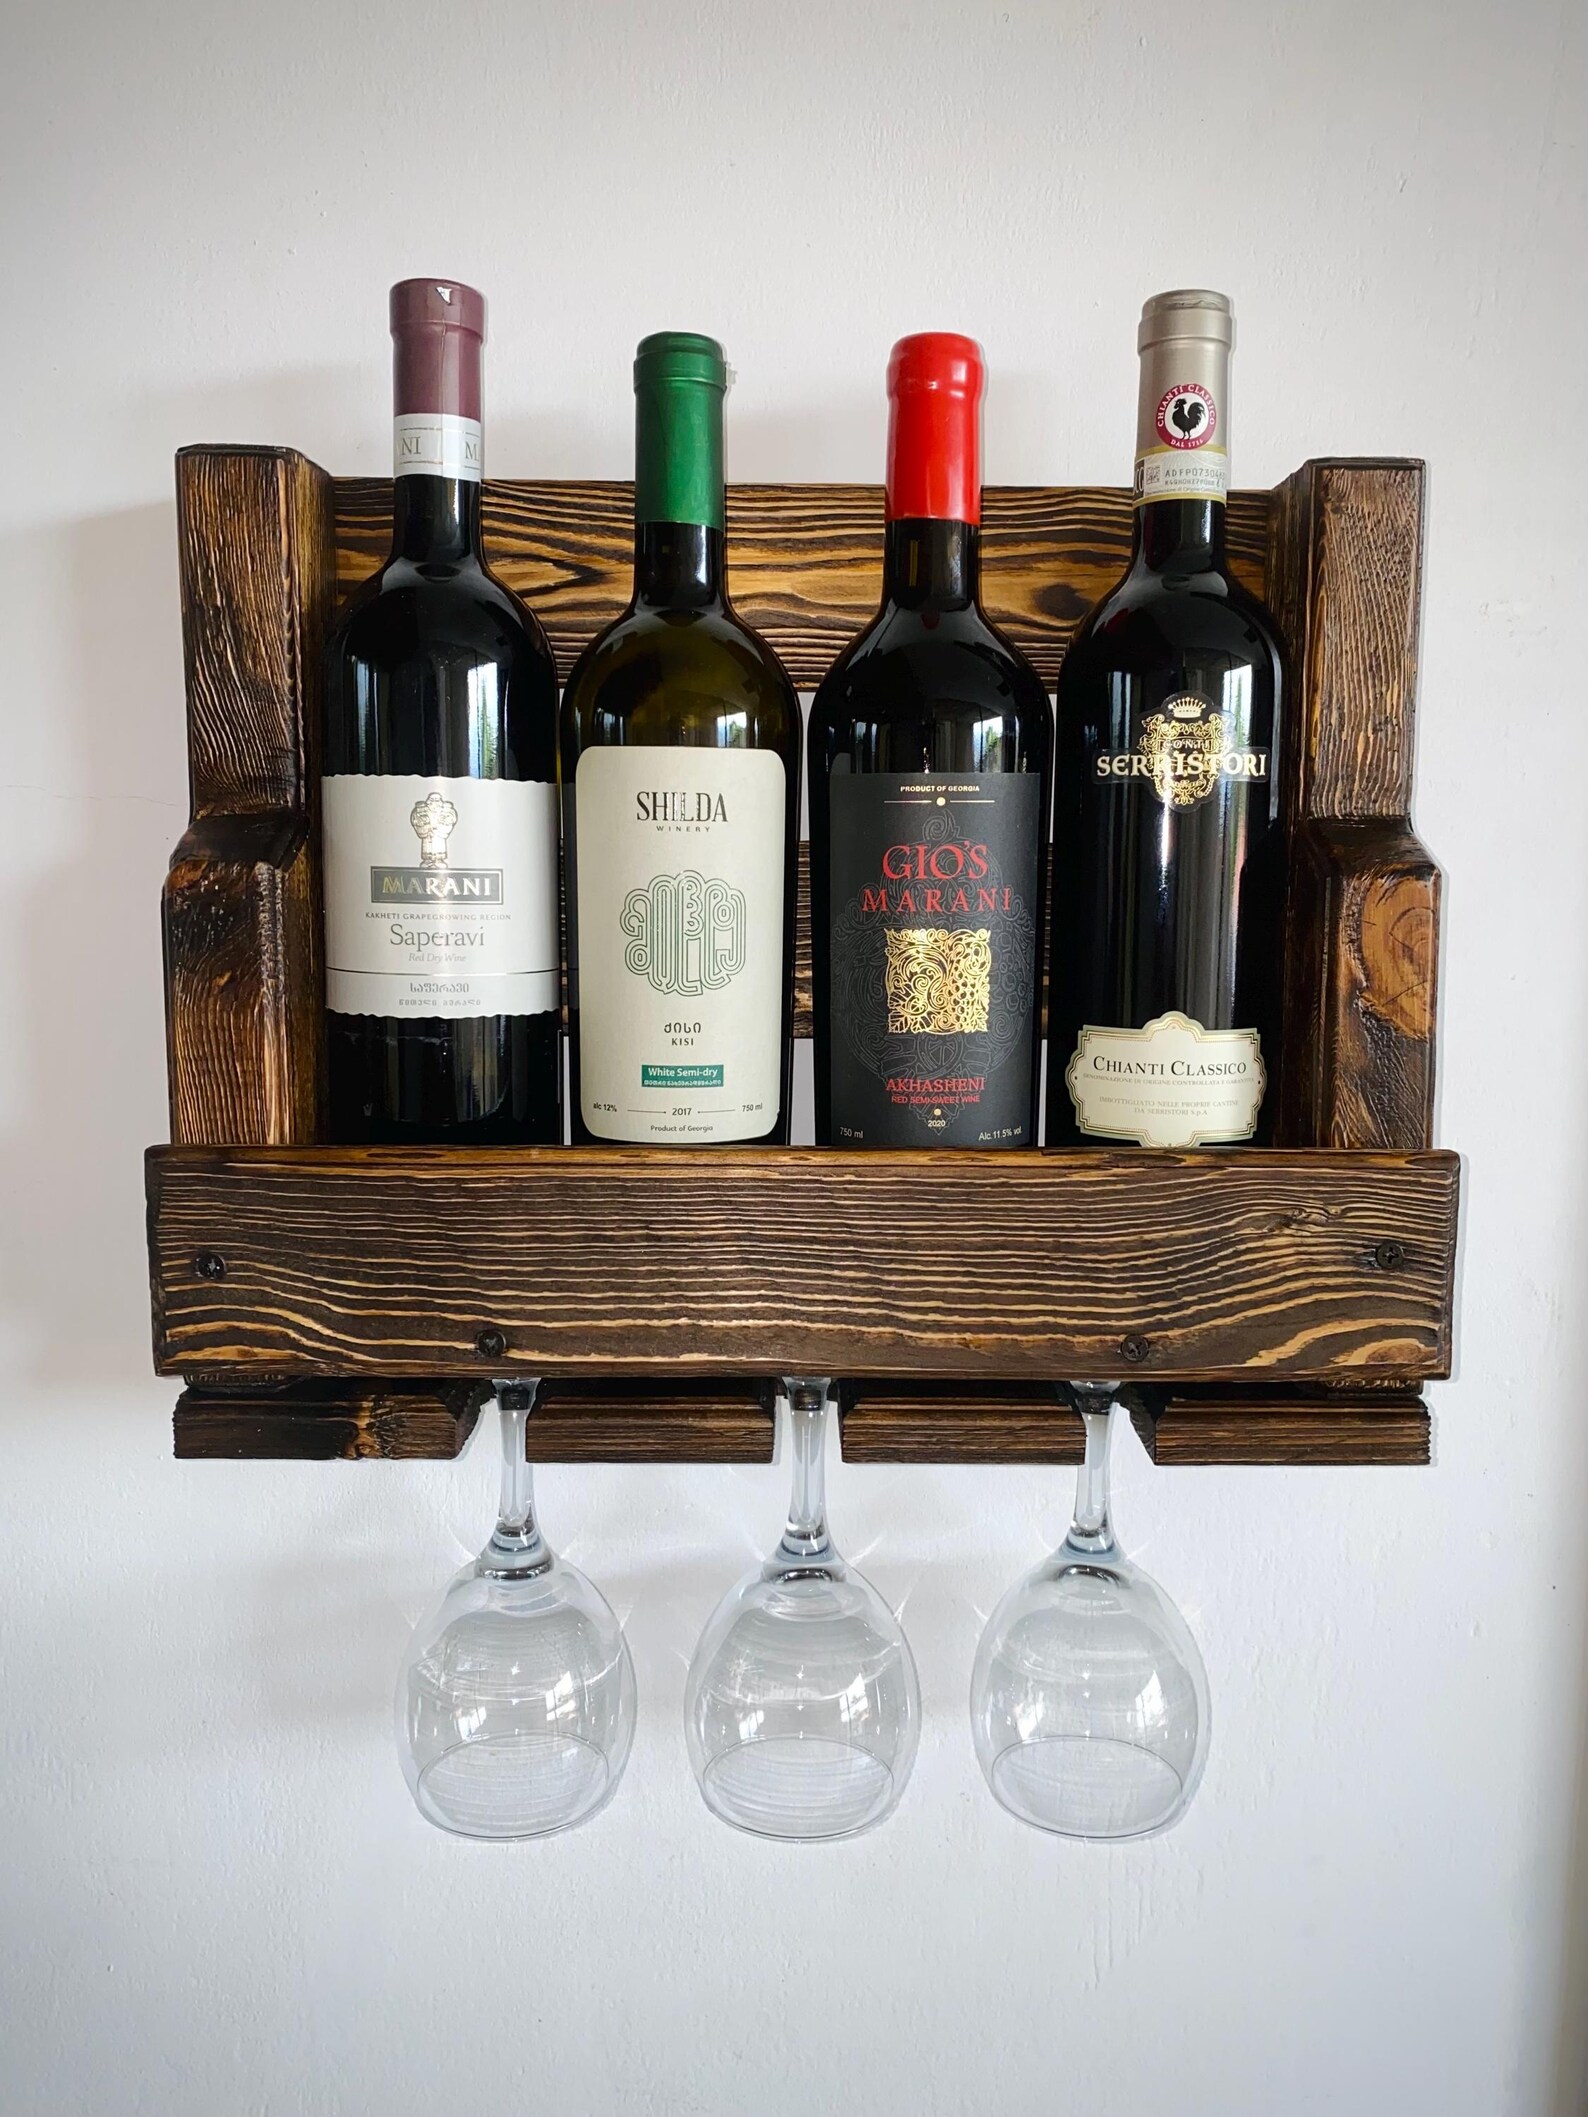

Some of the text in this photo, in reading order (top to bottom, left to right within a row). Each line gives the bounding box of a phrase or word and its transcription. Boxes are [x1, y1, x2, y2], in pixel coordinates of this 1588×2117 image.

[1158, 385, 1215, 427] CHIANTI CLASSICO
[1171, 439, 1184, 447] DAL
[1096, 753, 1267, 777] SERRISTORI
[636, 791, 728, 822] SHILDA
[882, 840, 988, 879] GIO'S
[382, 876, 491, 897] MARANI
[862, 887, 1012, 913] MARANI
[365, 911, 511, 921] KAKHETI GRAPEGROWING REGION
[390, 923, 485, 952] Saperavi
[408, 953, 467, 963] Red Dry Wine
[410, 982, 469, 993] საფერავი
[671, 1038, 694, 1046] KISI
[1093, 1055, 1247, 1076] CHIANTI CLASSICO
[648, 1067, 718, 1078] White Semi-dry
[886, 1077, 986, 1092] AKHASHENI
[910, 1096, 959, 1104] SEMI-SWEET
[961, 1095, 980, 1103] WINE
[593, 1102, 617, 1112] alc 12%
[672, 1108, 692, 1116] 2017
[742, 1104, 754, 1112] 750
[927, 1119, 946, 1127] 2020
[688, 1125, 713, 1133] Georgia
[840, 1127, 864, 1139] 750 ml
